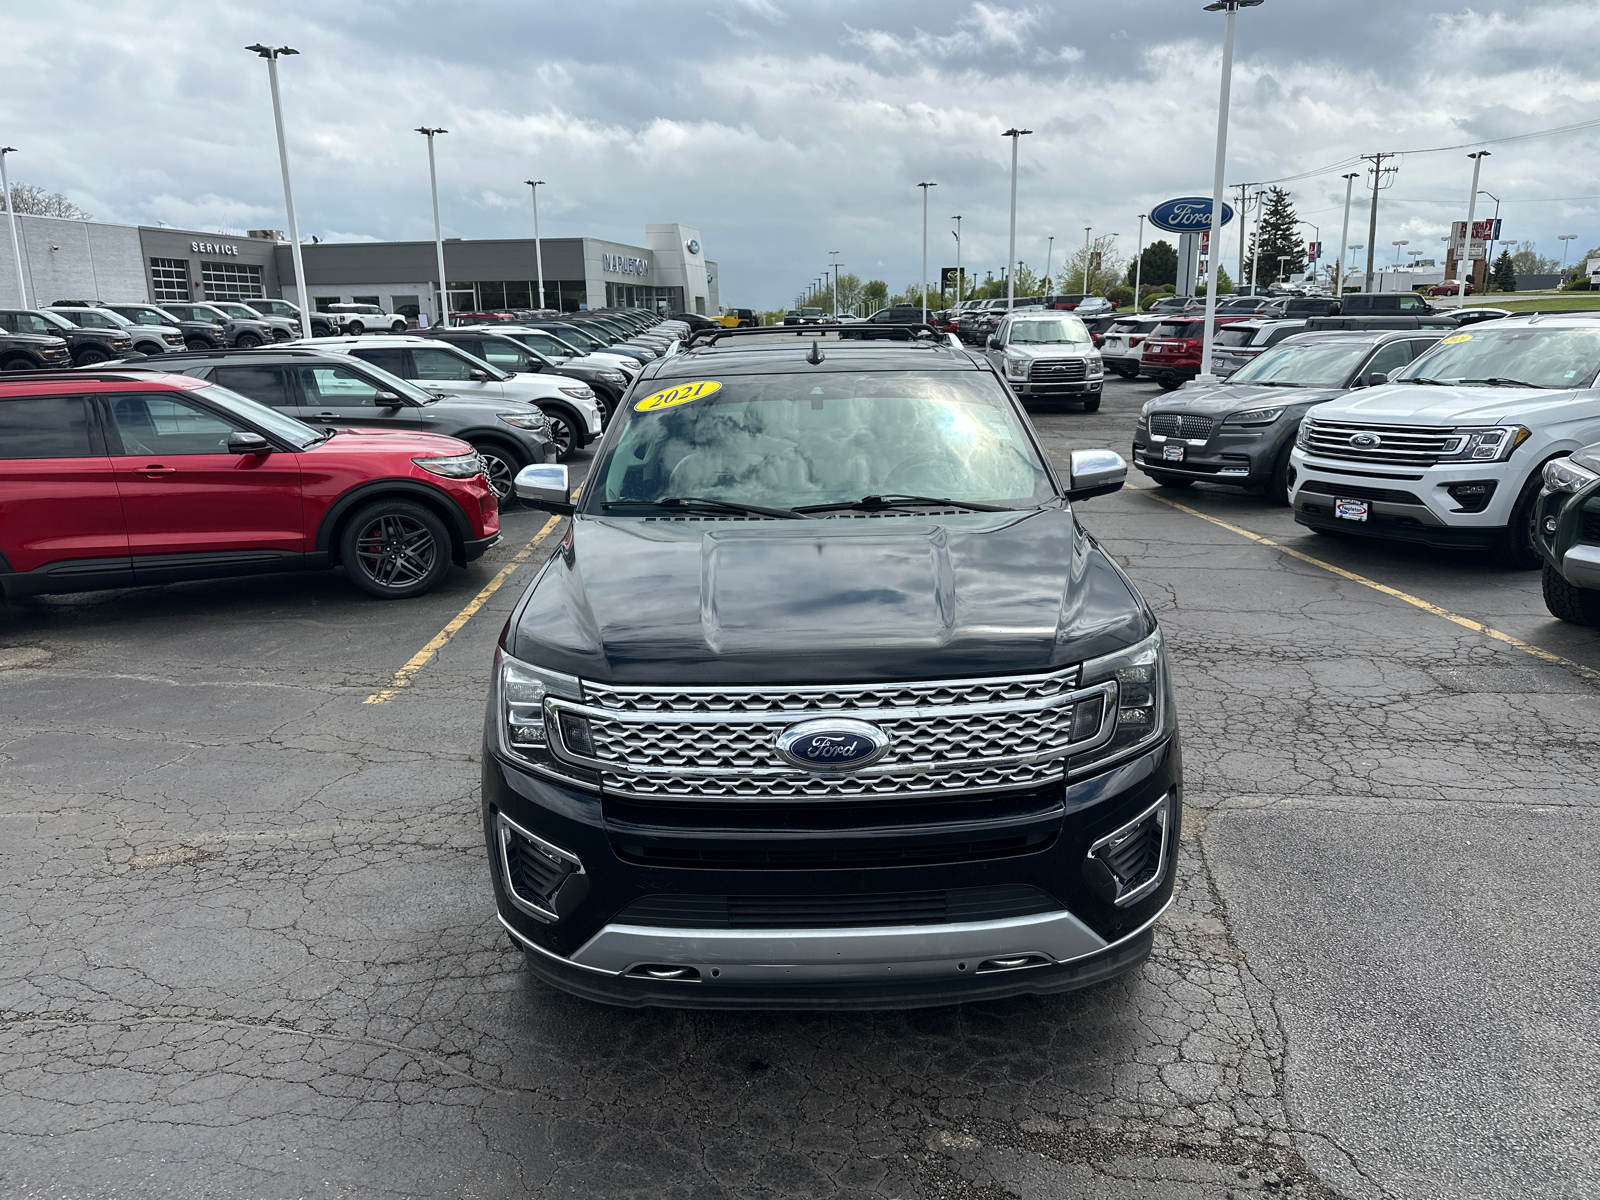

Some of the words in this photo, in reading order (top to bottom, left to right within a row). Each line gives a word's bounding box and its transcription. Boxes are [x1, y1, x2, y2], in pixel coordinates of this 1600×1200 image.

[191, 241, 239, 256] SERVICE
[602, 253, 649, 276] NAPLETON
[649, 383, 706, 408] 2021
[807, 736, 858, 758] Ford
